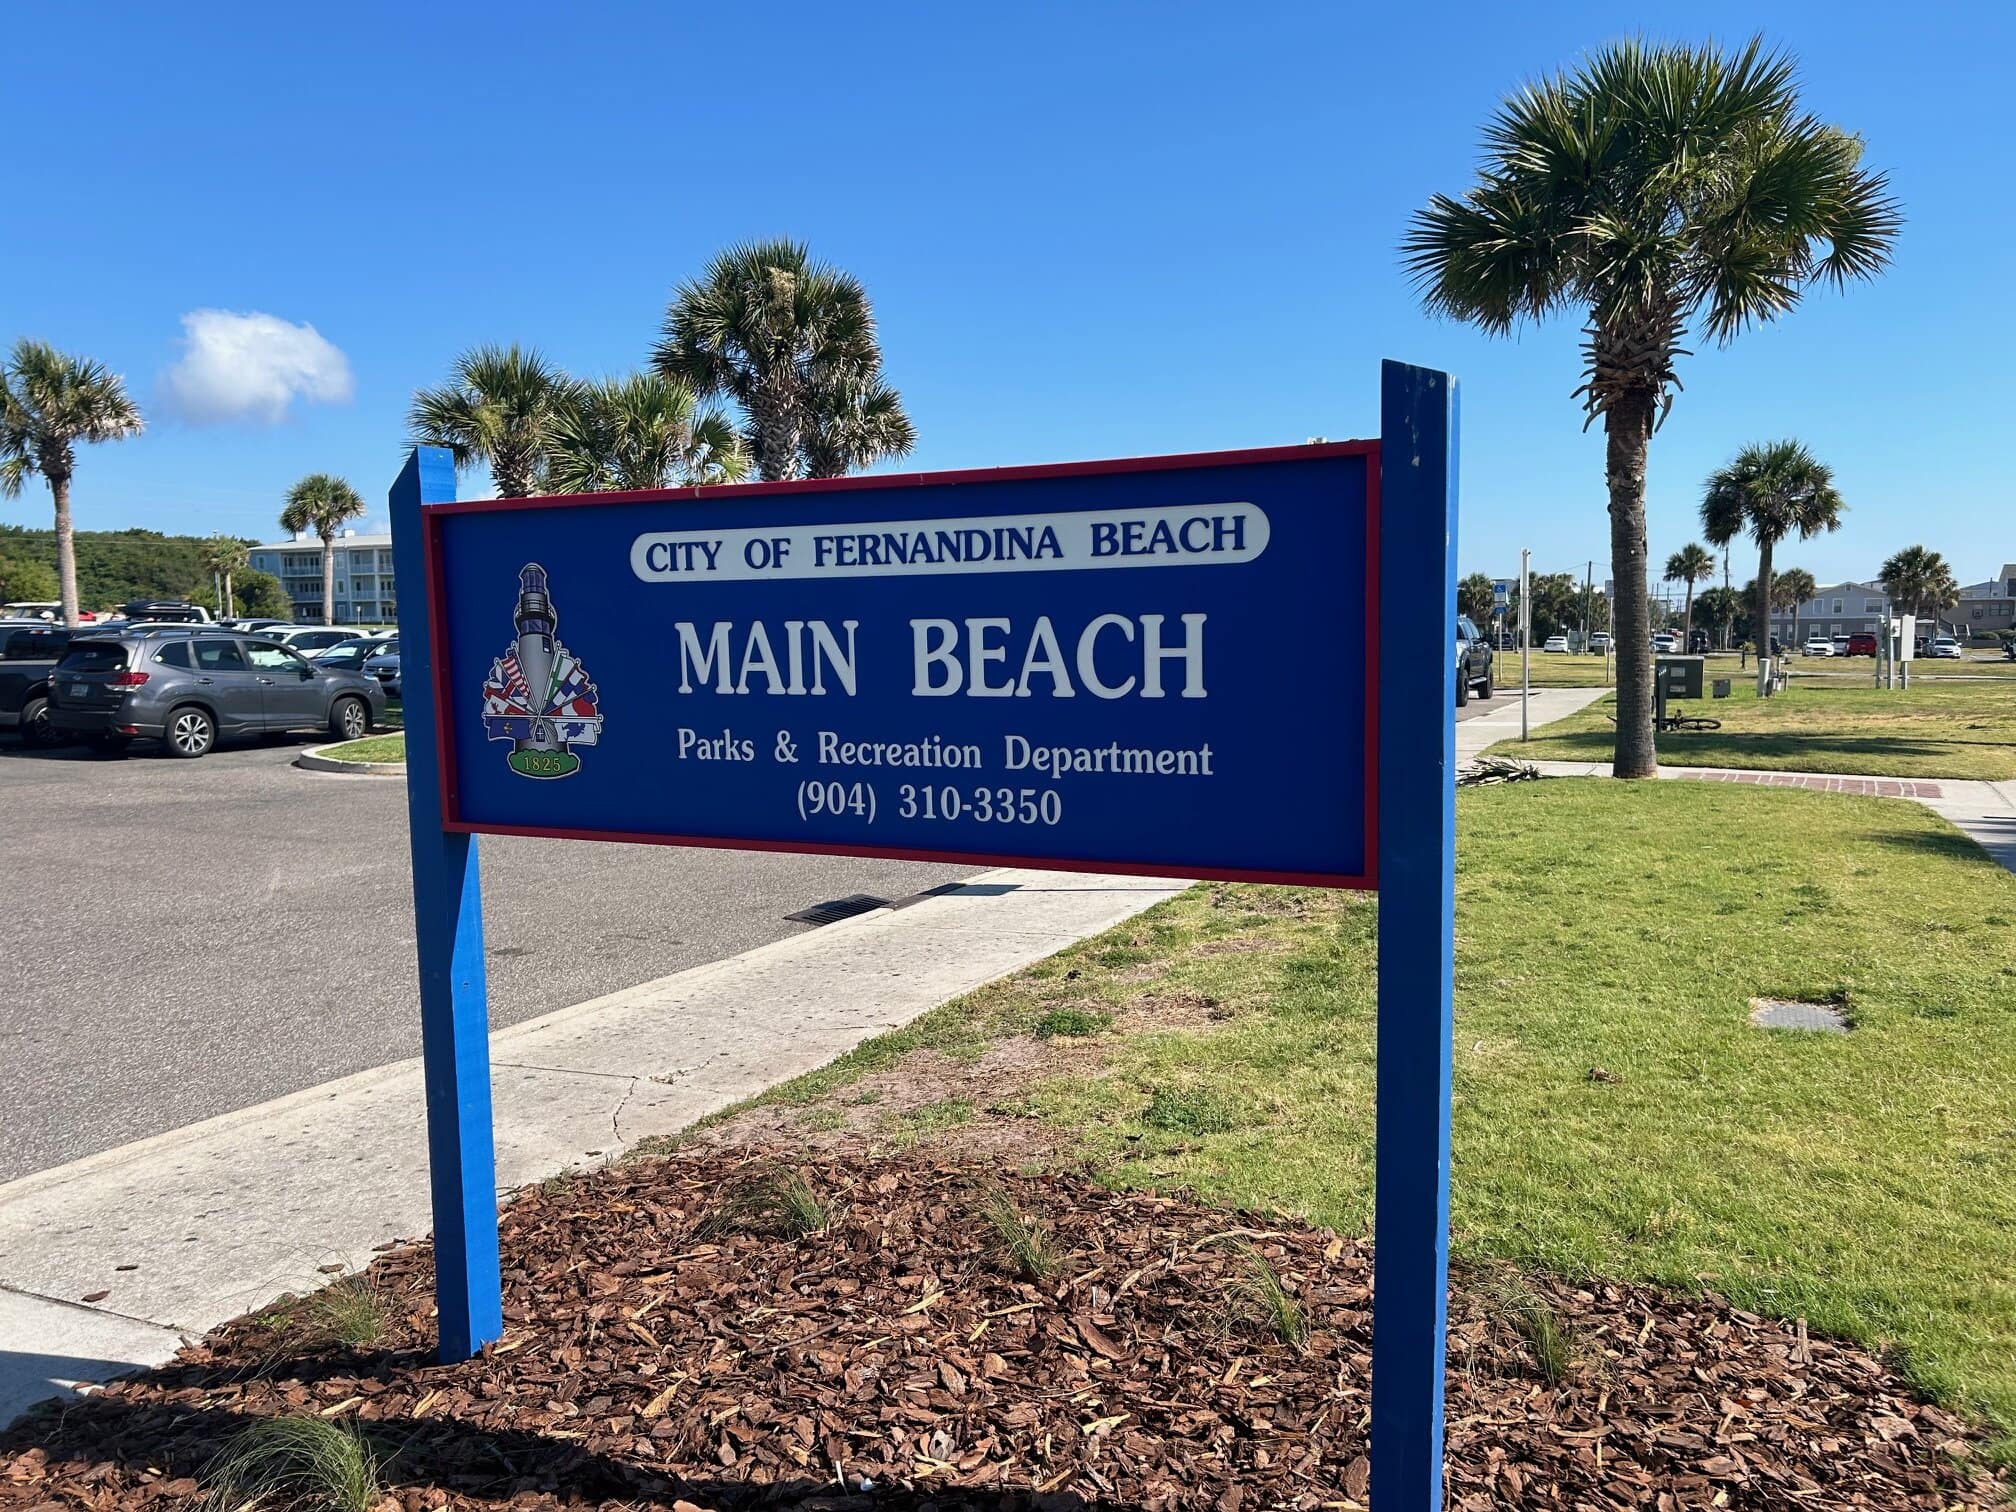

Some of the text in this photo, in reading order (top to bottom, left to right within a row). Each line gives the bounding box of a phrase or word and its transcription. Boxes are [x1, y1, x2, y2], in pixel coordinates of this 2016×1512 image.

[645, 514, 1247, 573] CITY OF FERNANDINA BEACH
[674, 613, 1208, 699] MAIN BEACH
[524, 757, 561, 772] 1825
[676, 728, 1215, 779] Parks & Recreation Department
[797, 780, 1063, 826] (904) 310-3350
